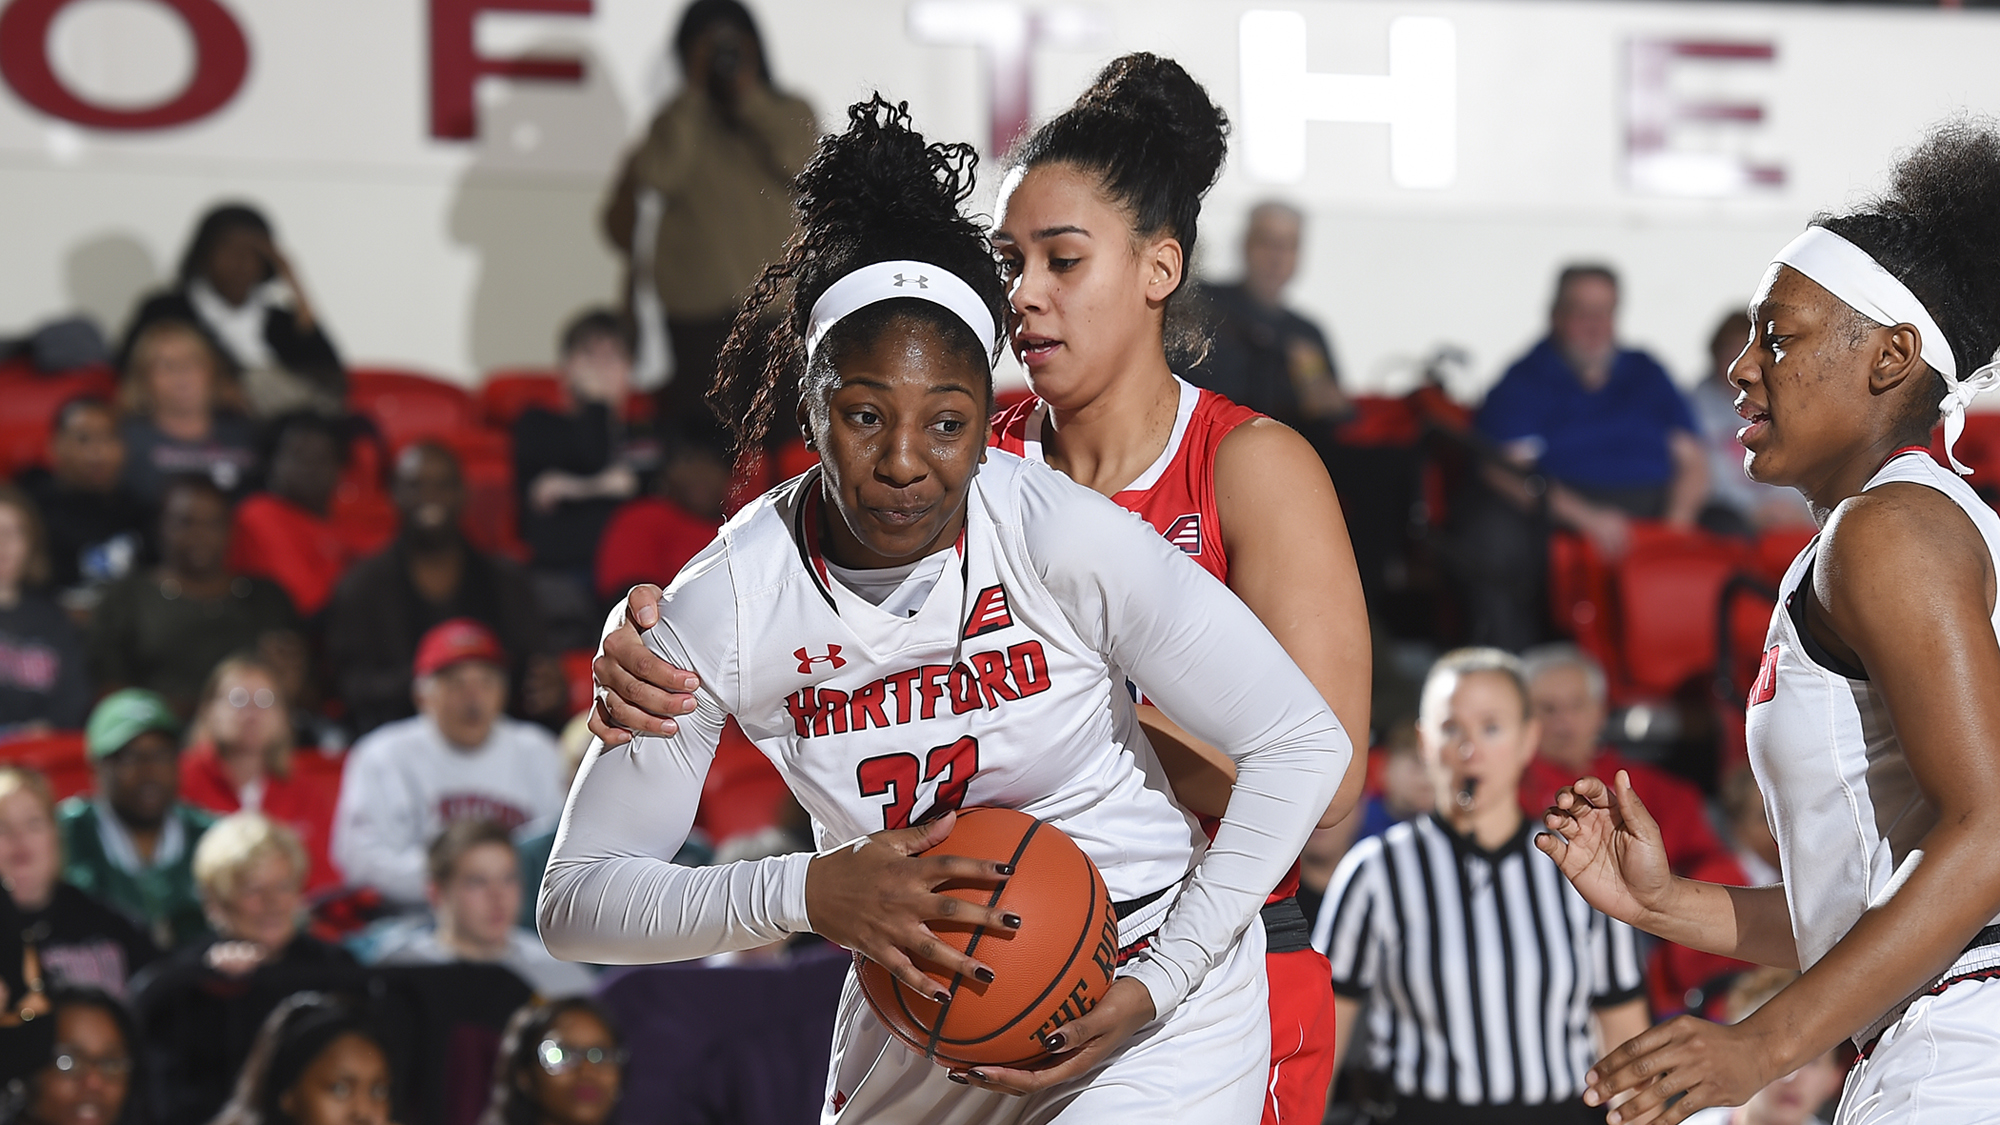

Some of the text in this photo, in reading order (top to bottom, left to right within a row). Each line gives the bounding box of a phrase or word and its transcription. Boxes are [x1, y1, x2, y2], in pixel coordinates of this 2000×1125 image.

[0, 0, 1788, 191] OF THE
[784, 639, 1052, 738] HARTFORD
[1029, 978, 1097, 1050] THE
